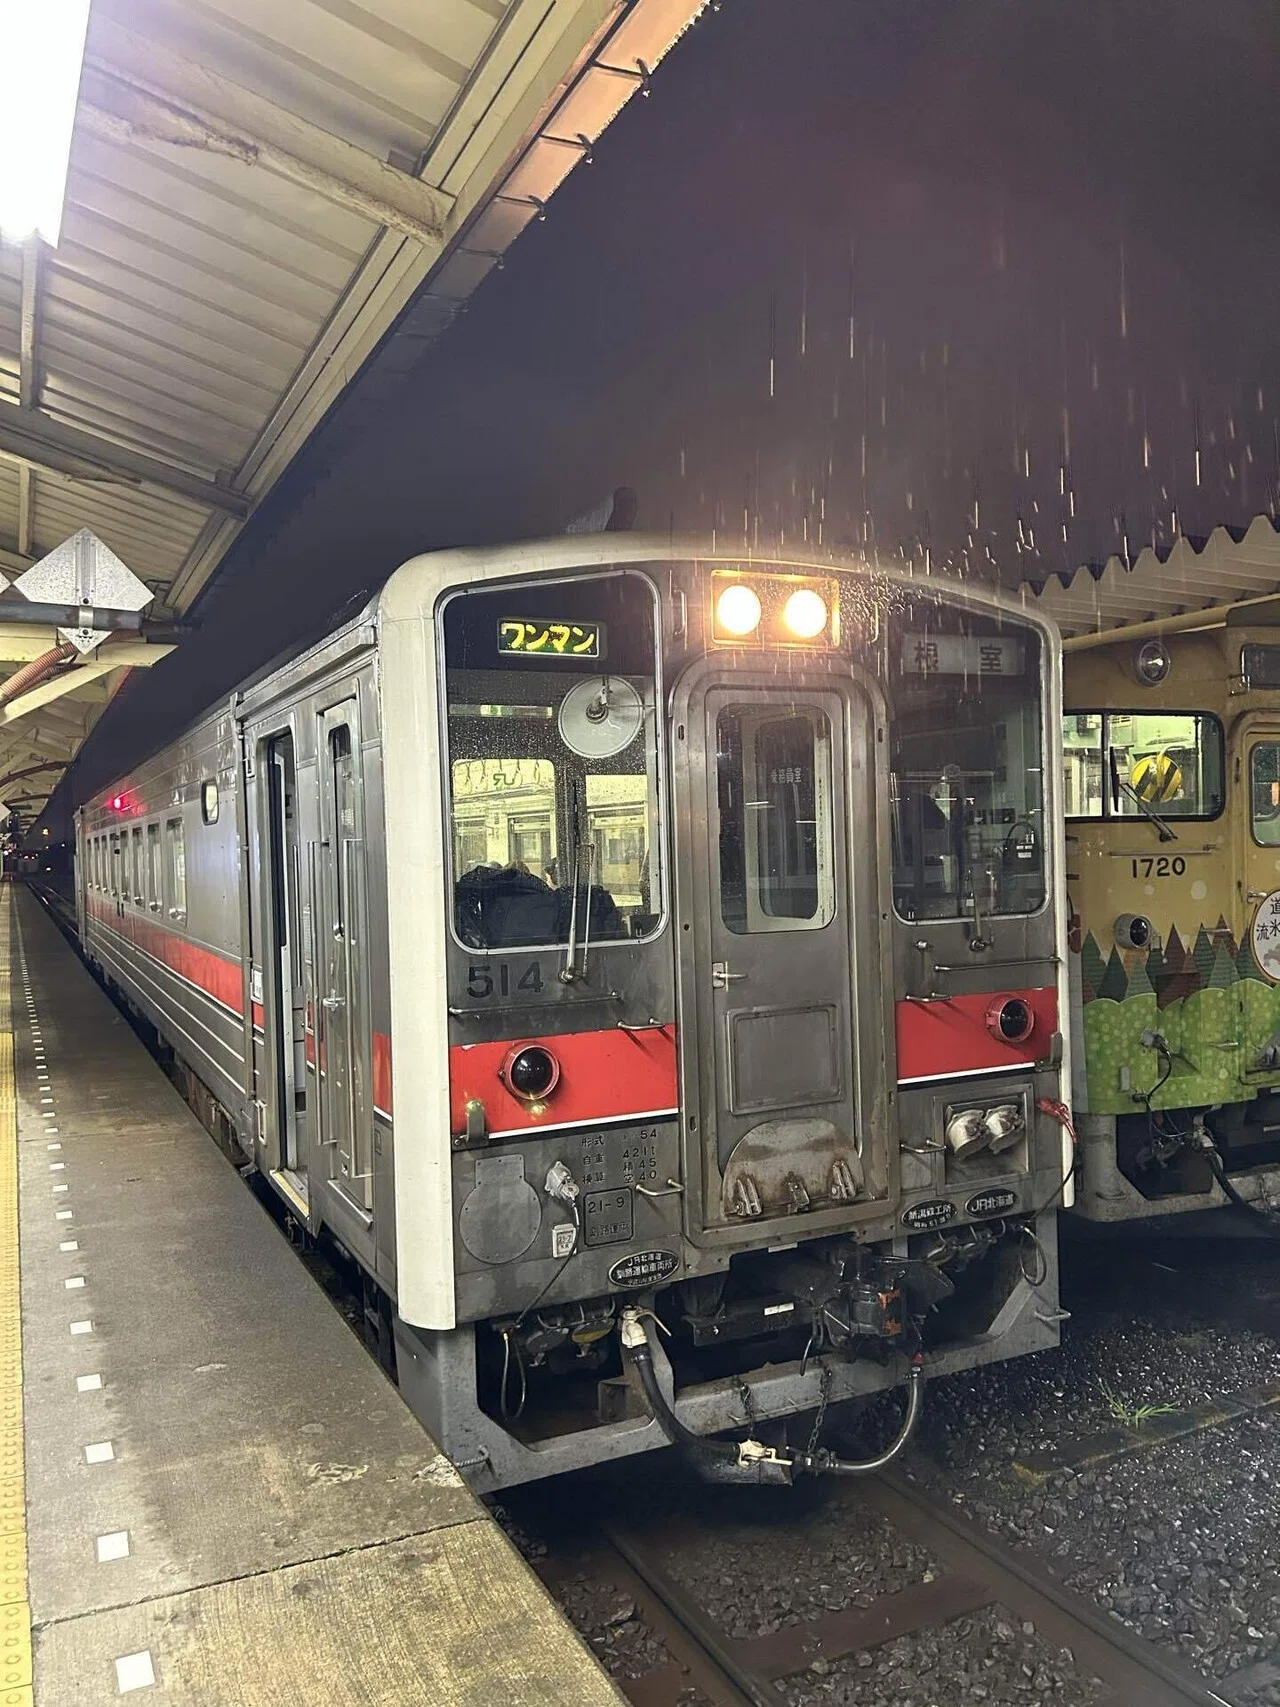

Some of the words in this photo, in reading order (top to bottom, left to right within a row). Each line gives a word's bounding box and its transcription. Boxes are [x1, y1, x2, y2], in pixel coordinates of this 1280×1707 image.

[501, 622, 594, 653] ワンマン
[914, 640, 1003, 673] 根室
[1132, 856, 1186, 878] 1720
[466, 961, 544, 998] 514
[581, 1134, 605, 1148] 形式
[640, 1128, 657, 1140] 54
[583, 1153, 604, 1166] 自重
[971, 1193, 1014, 1212] JR北海道
[627, 1252, 662, 1267] JR北海道
